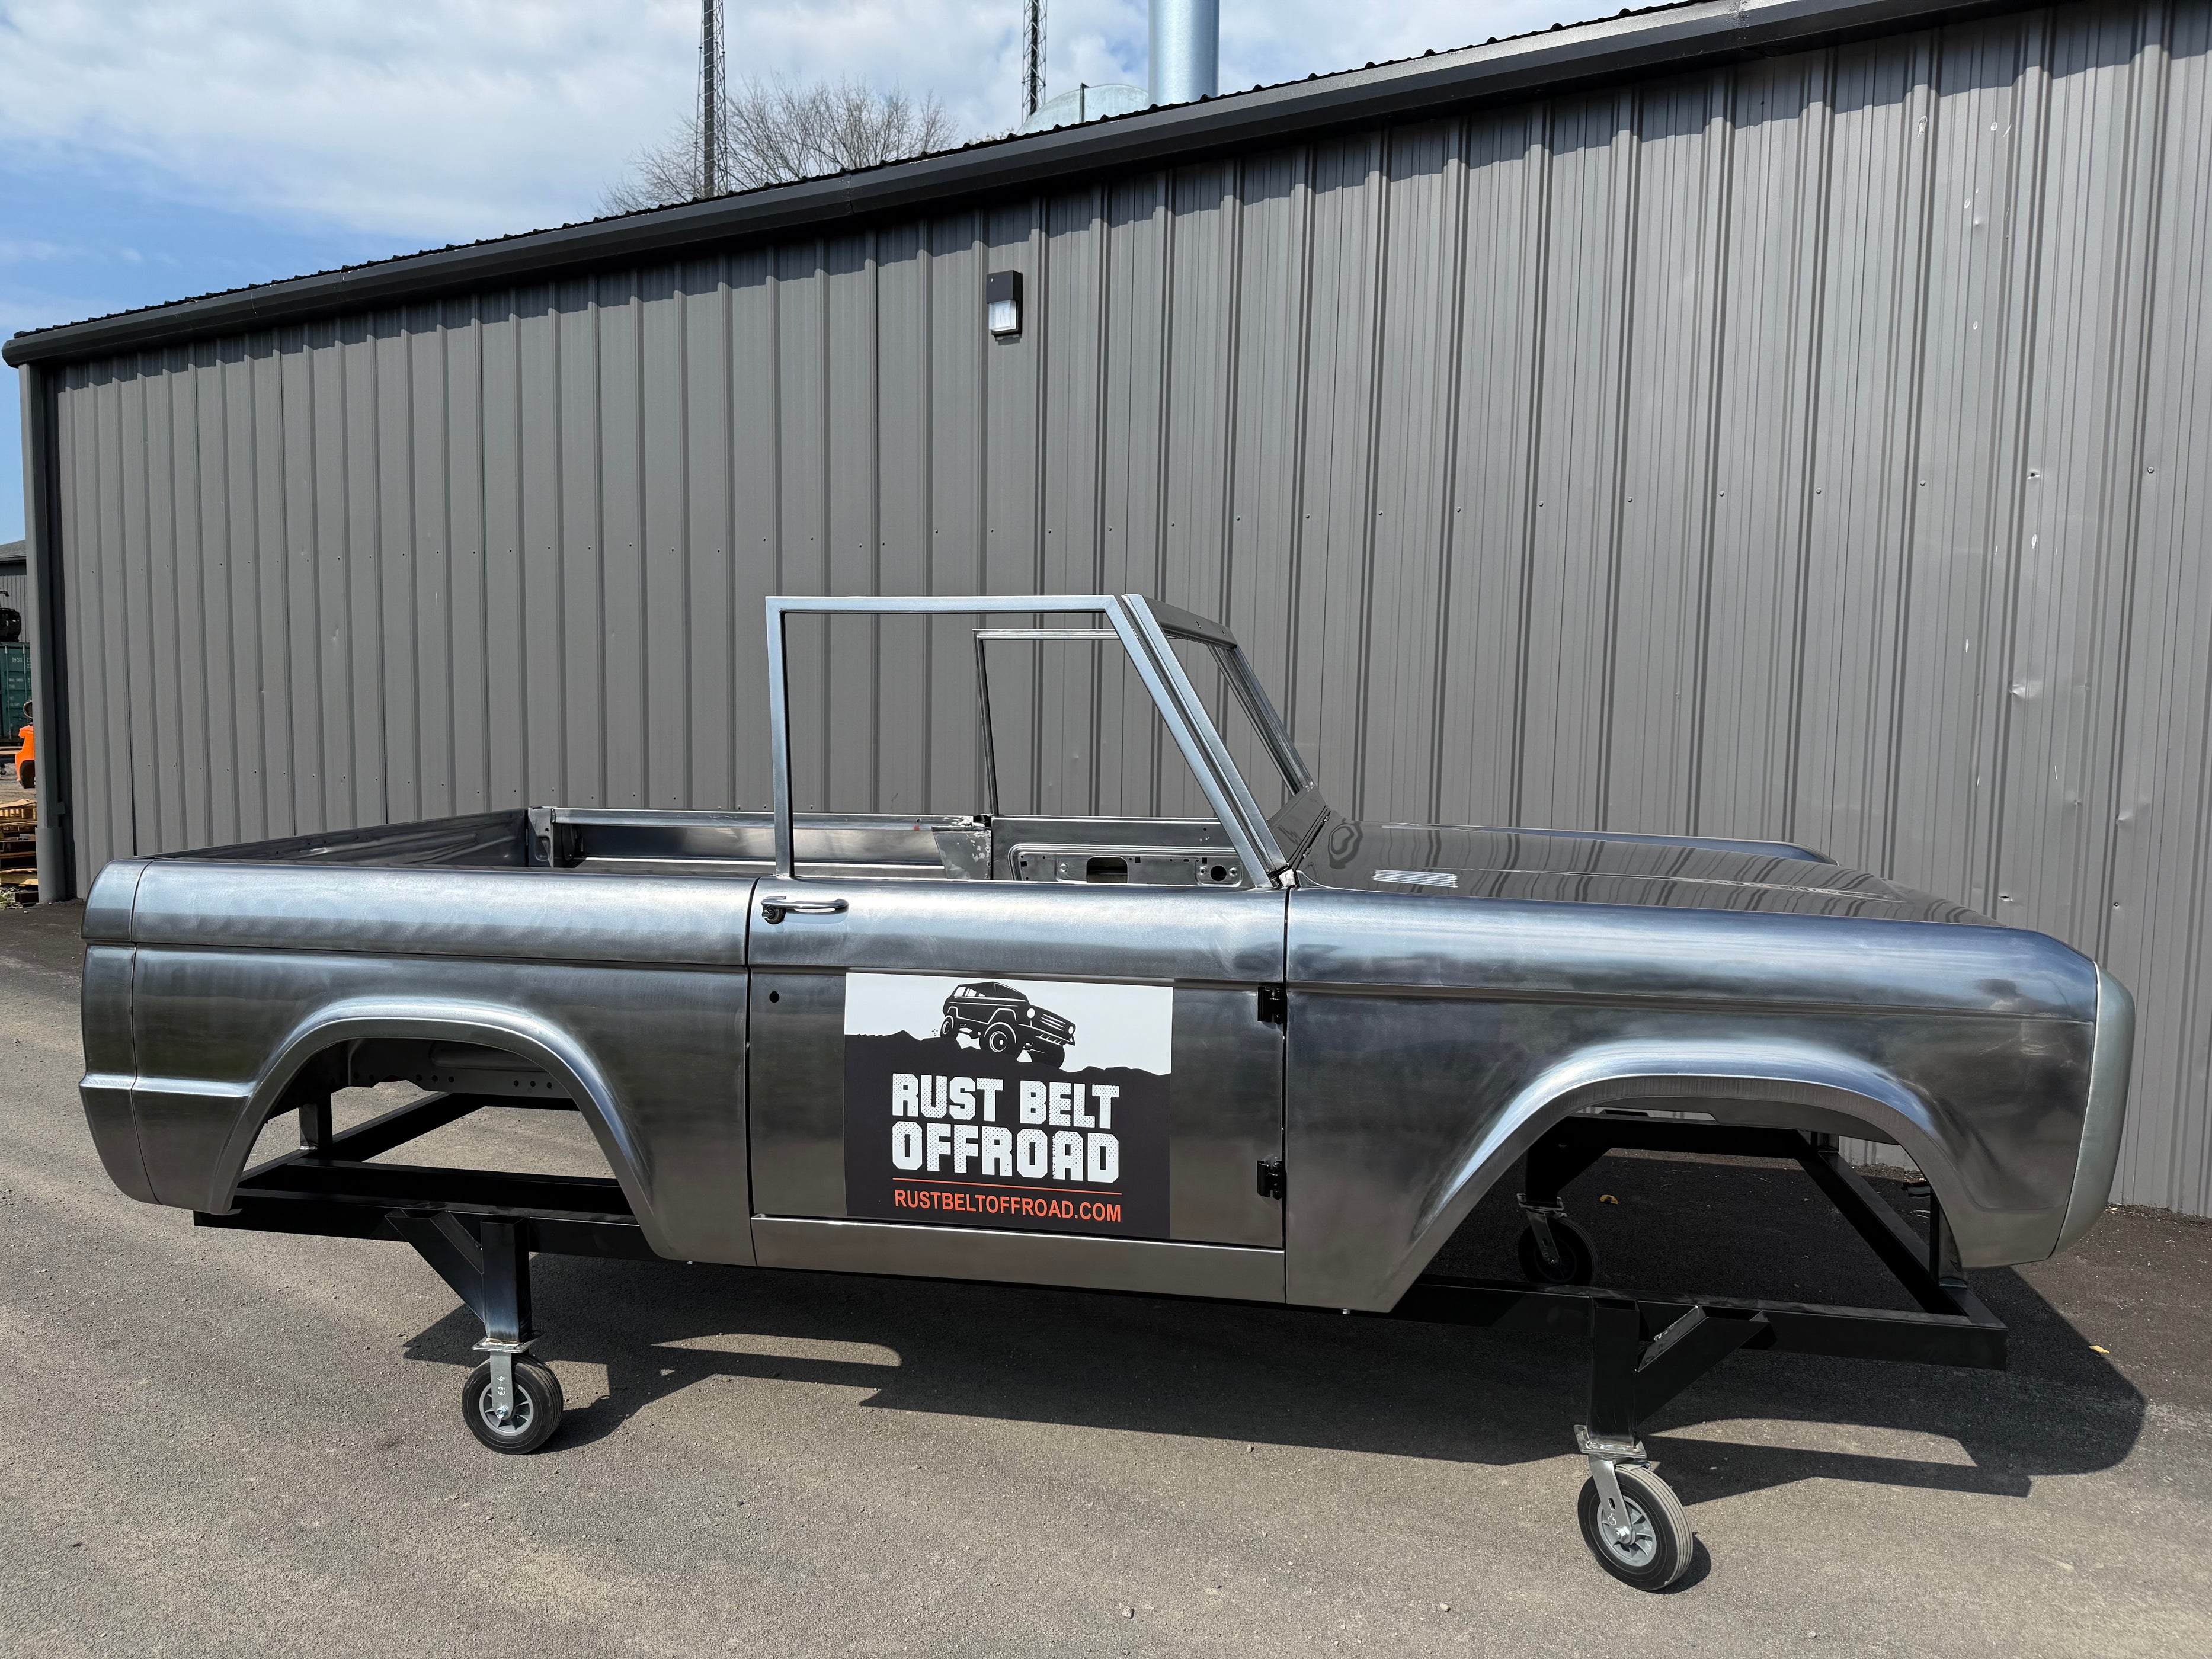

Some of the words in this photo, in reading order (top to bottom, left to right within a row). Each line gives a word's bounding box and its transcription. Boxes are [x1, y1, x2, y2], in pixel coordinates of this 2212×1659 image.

[892, 1073, 1004, 1122] RUST
[1020, 1080, 1119, 1129] BELT
[892, 1120, 1119, 1184] OFFROAD
[894, 1189, 1122, 1222] RUSTBELTOFFROAD.COM
